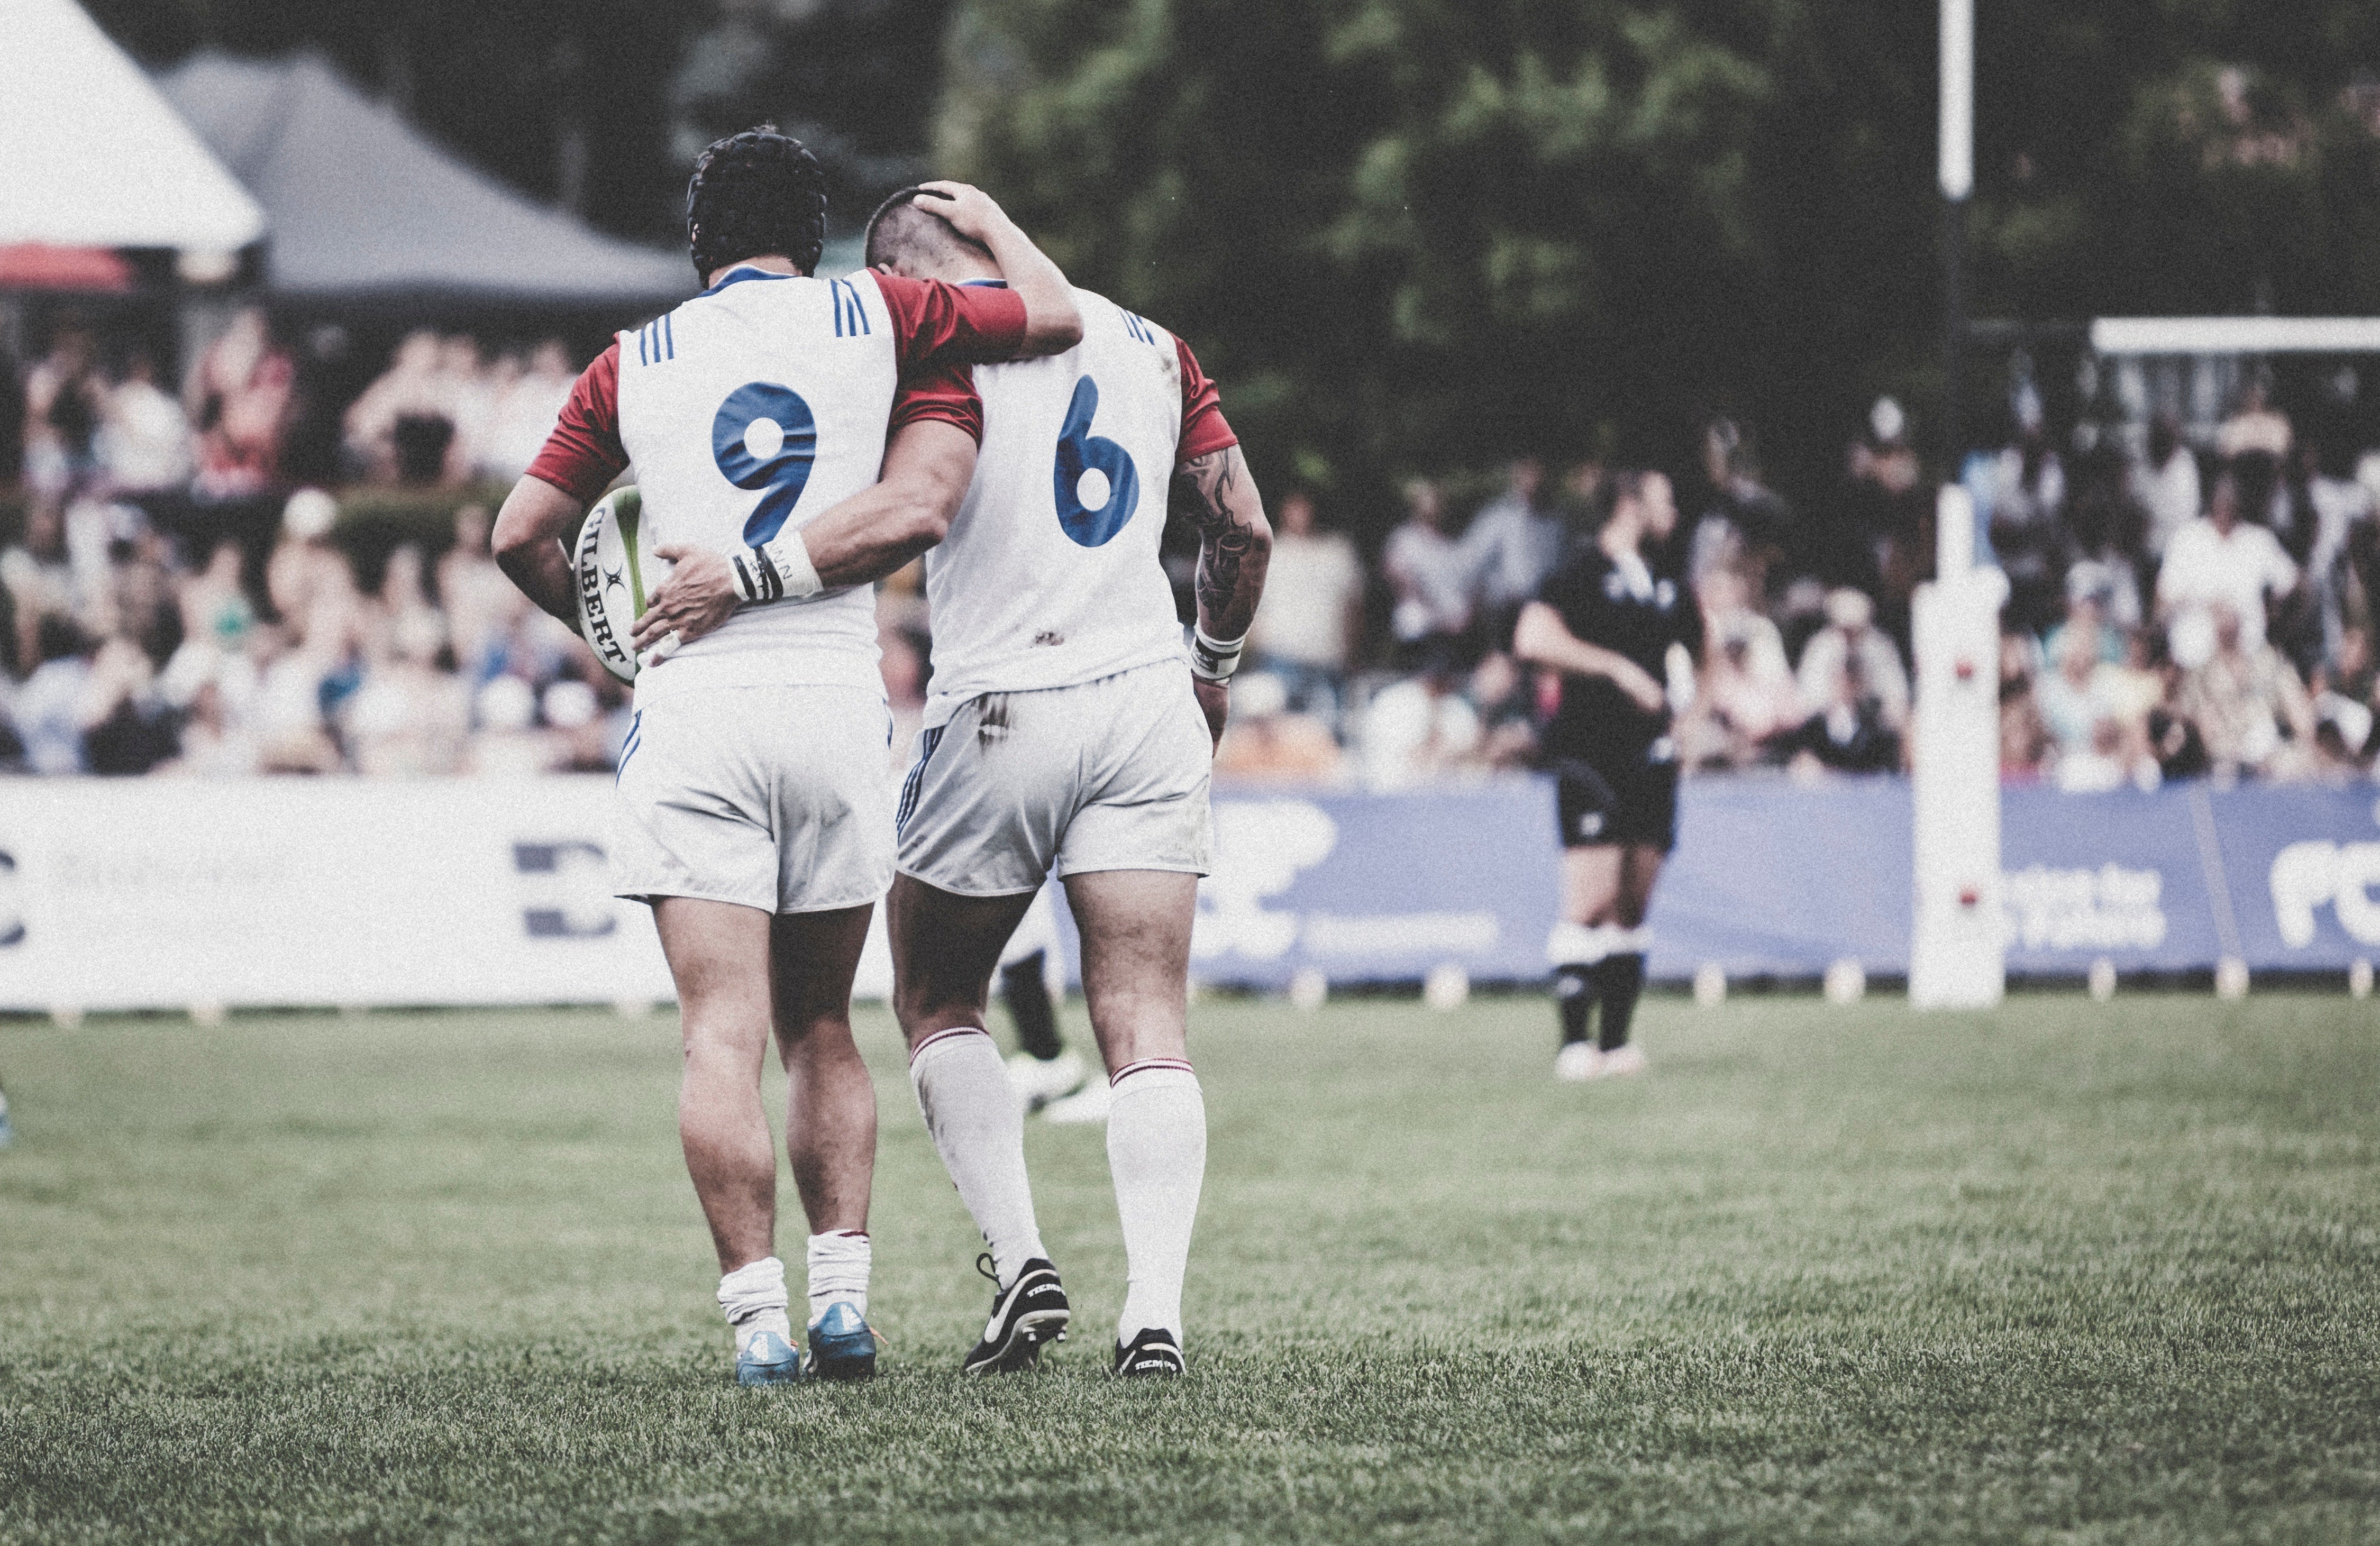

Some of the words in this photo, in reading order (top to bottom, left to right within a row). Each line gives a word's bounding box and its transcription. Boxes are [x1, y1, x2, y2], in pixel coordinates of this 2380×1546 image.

[712, 381, 817, 549] 9
[1053, 374, 1140, 547] 6
[581, 507, 627, 662] GILBERT
[1135, 1360, 1177, 1372] TIEMPO
